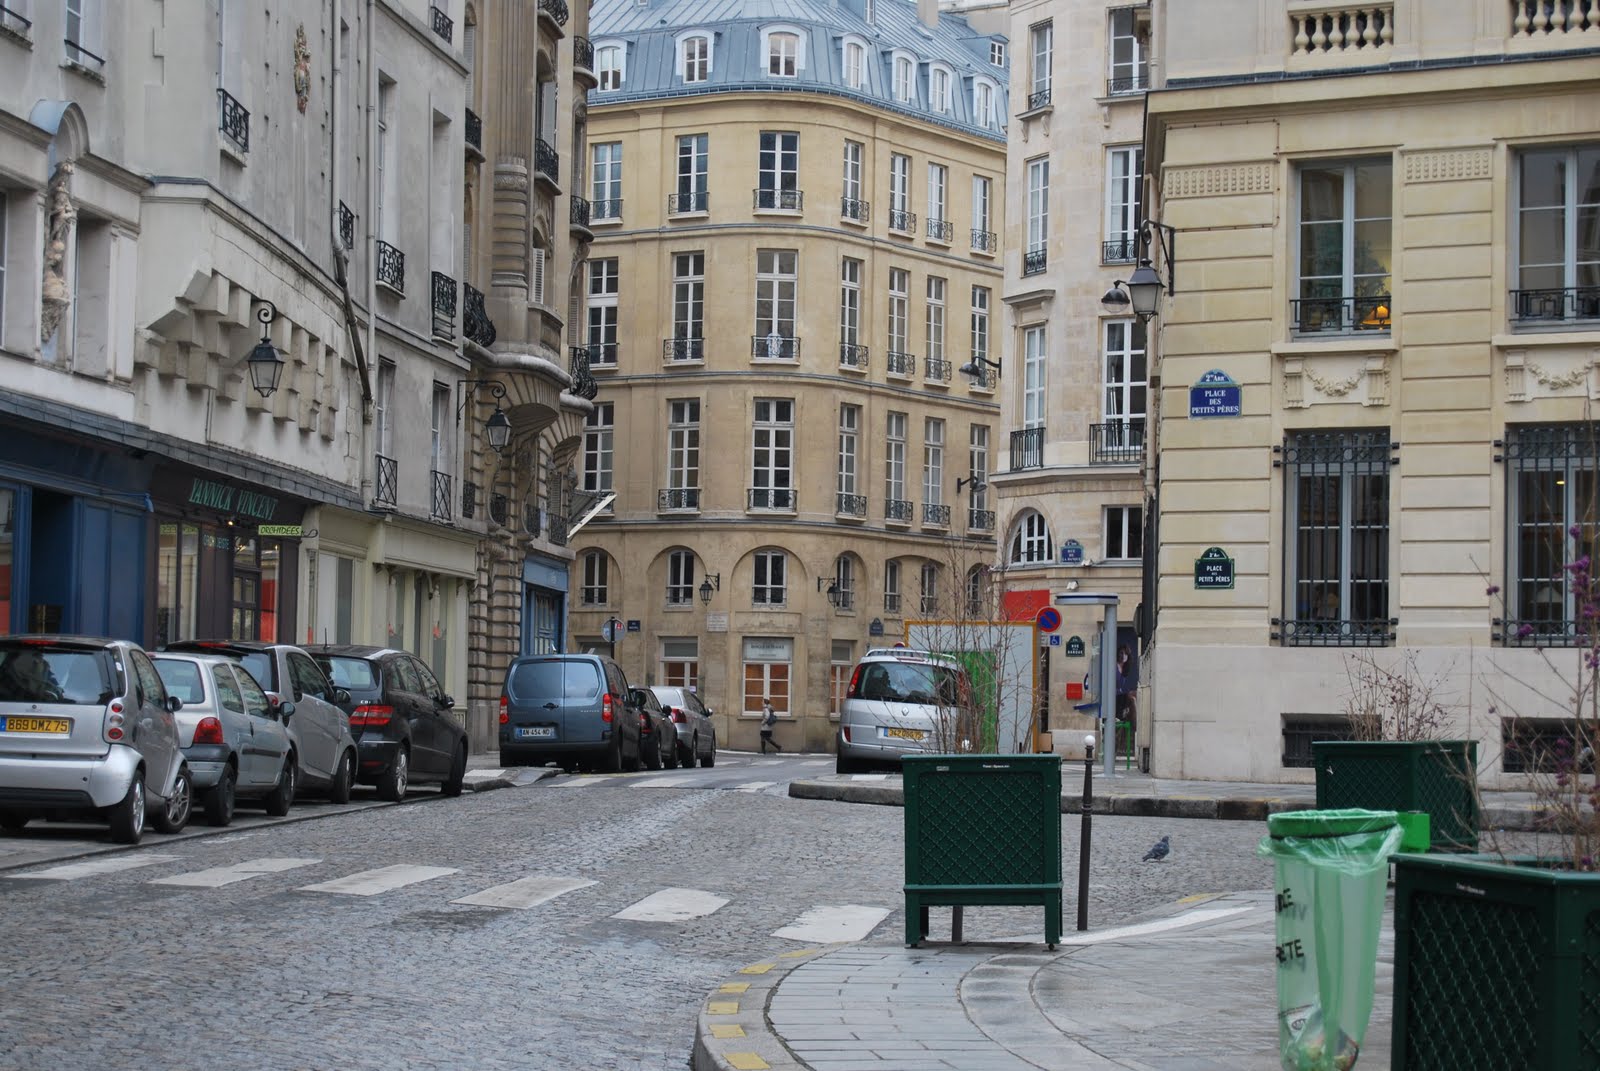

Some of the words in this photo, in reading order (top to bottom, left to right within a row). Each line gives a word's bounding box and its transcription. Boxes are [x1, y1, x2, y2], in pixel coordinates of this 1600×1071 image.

[1191, 406, 1215, 414] PETITS
[1216, 405, 1239, 413] PÈRES
[188, 478, 236, 511] YANNICK
[236, 490, 279, 520] VINCENT
[8, 718, 29, 730] 869
[30, 719, 52, 731] DMZ
[53, 720, 68, 731] 75
